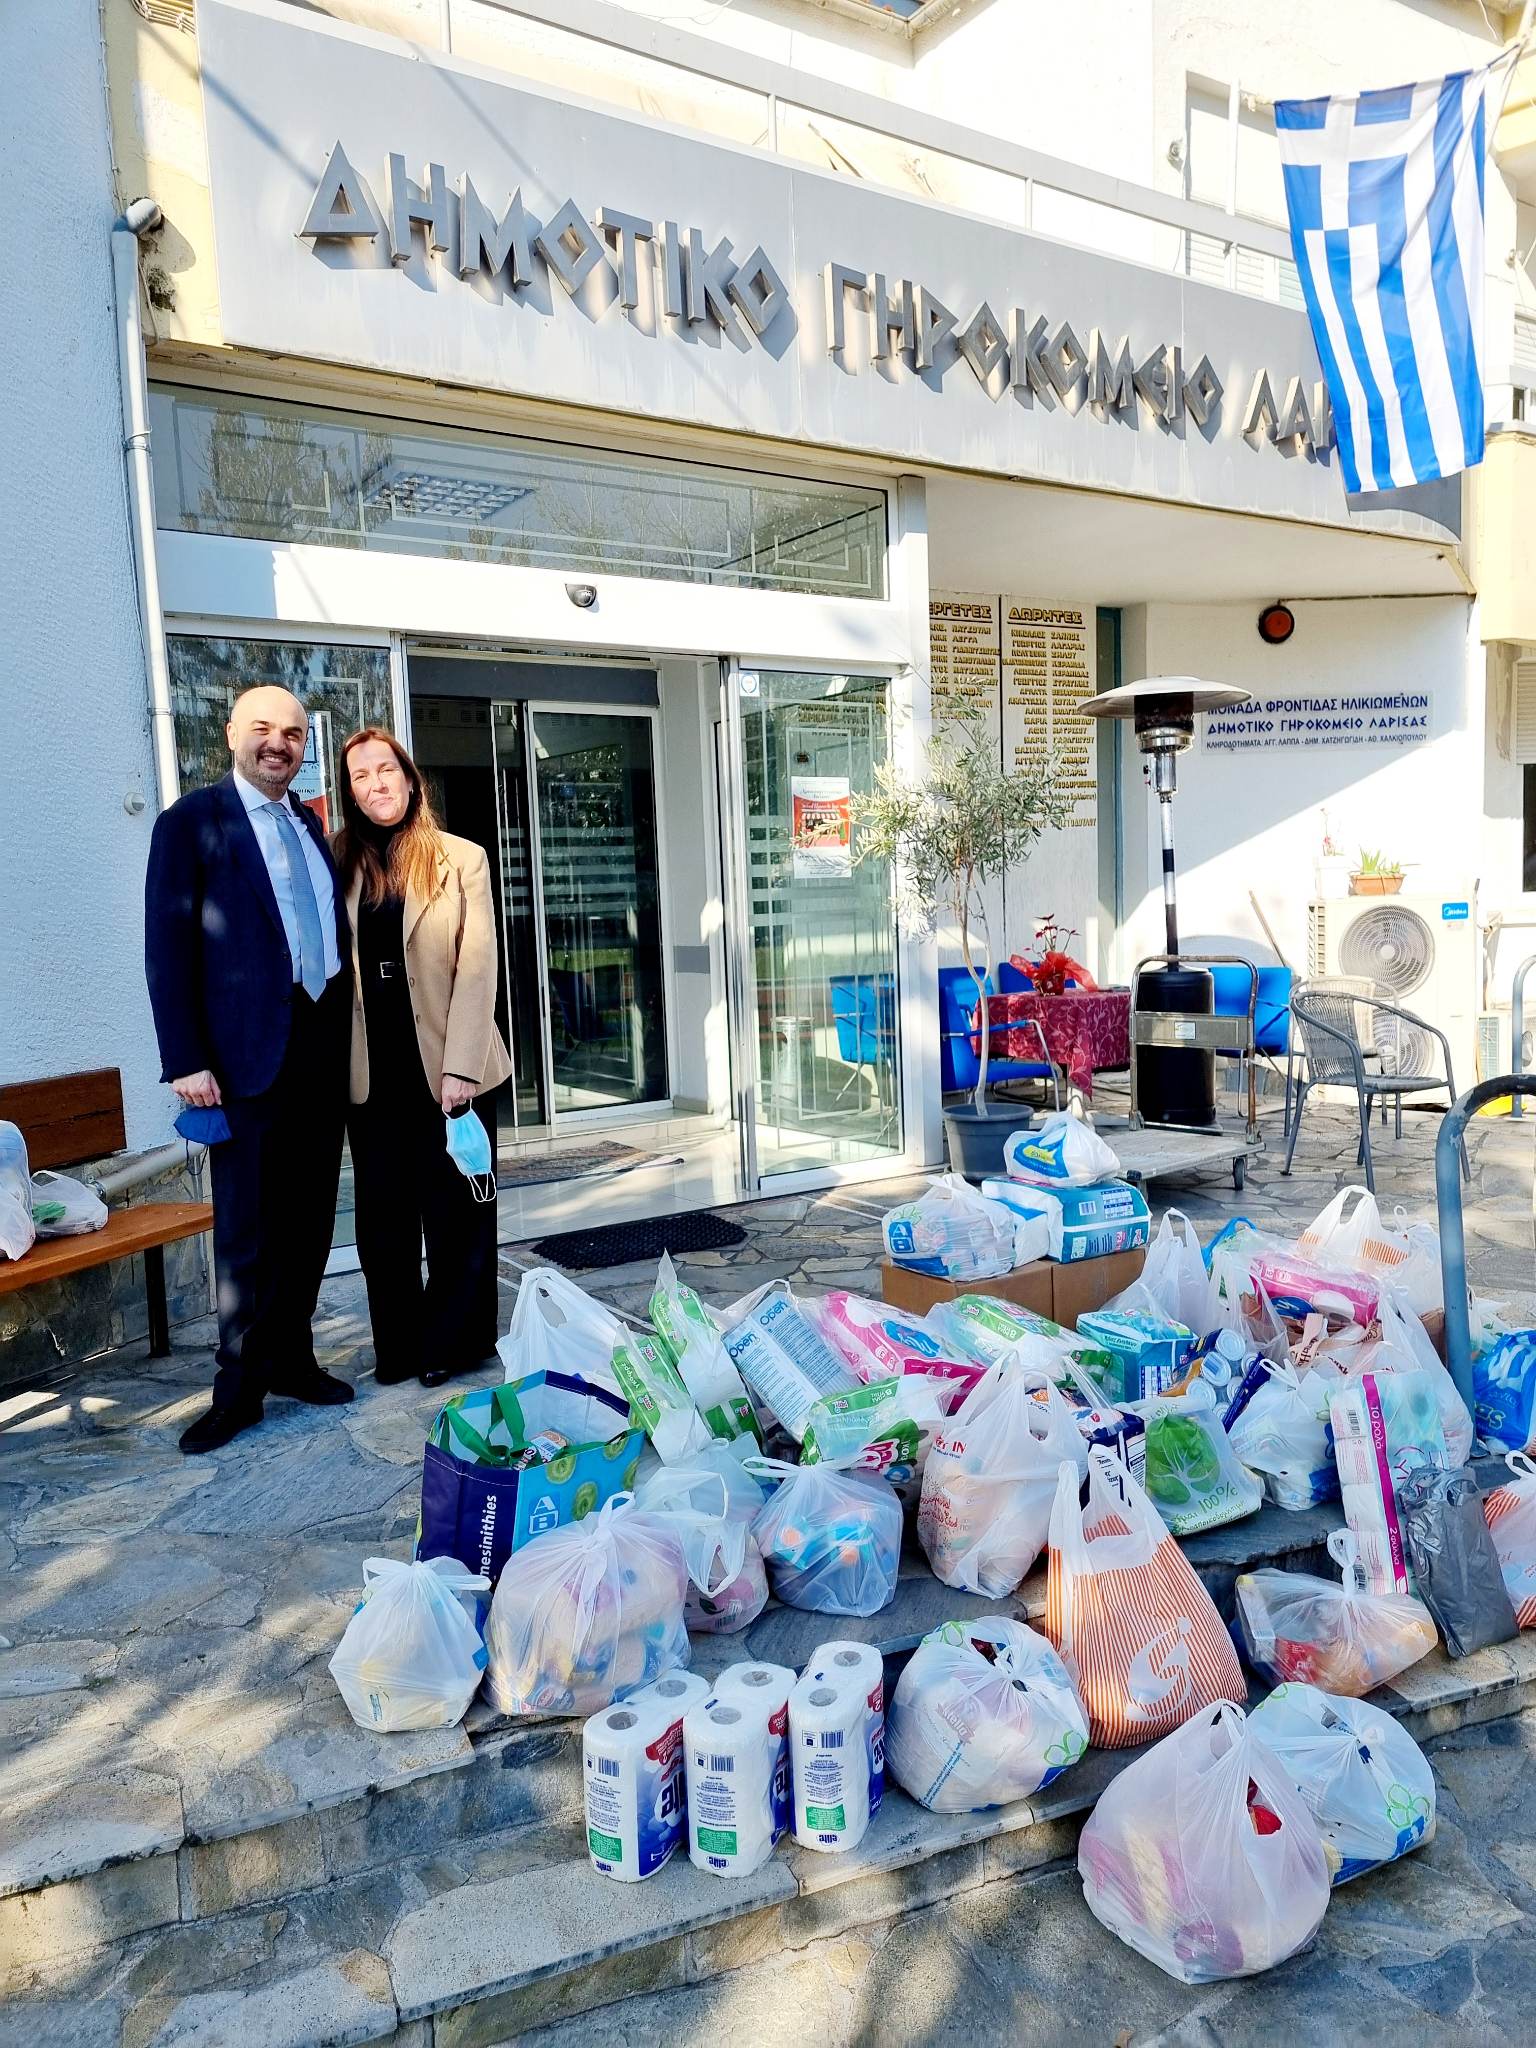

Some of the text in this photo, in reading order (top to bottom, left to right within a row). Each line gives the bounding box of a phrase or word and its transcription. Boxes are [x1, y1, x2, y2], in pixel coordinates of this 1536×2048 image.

[299, 139, 790, 335] ΔΗΜΟΤΙΚΟ
[824, 261, 1225, 427] ΓΗΡΟΚΟΜΕΙΟ
[1008, 607, 1083, 624] ΔΩΡΗΤΕΣ
[1265, 698, 1338, 713] ΦΡΟΝΤΙΔΑΣ
[1341, 695, 1428, 711] ΗΛΙΚΙΩΜΕΝΩΝ
[1207, 715, 1427, 735] ΔΗΜΟΤΙΚΟ ΓΗΡΟΚΟΜΕΙΟ ΛΑΡΙΣΑΣ
[759, 1300, 788, 1326] Open
[728, 1331, 757, 1358] Open
[1388, 1527, 1398, 1535] 2
